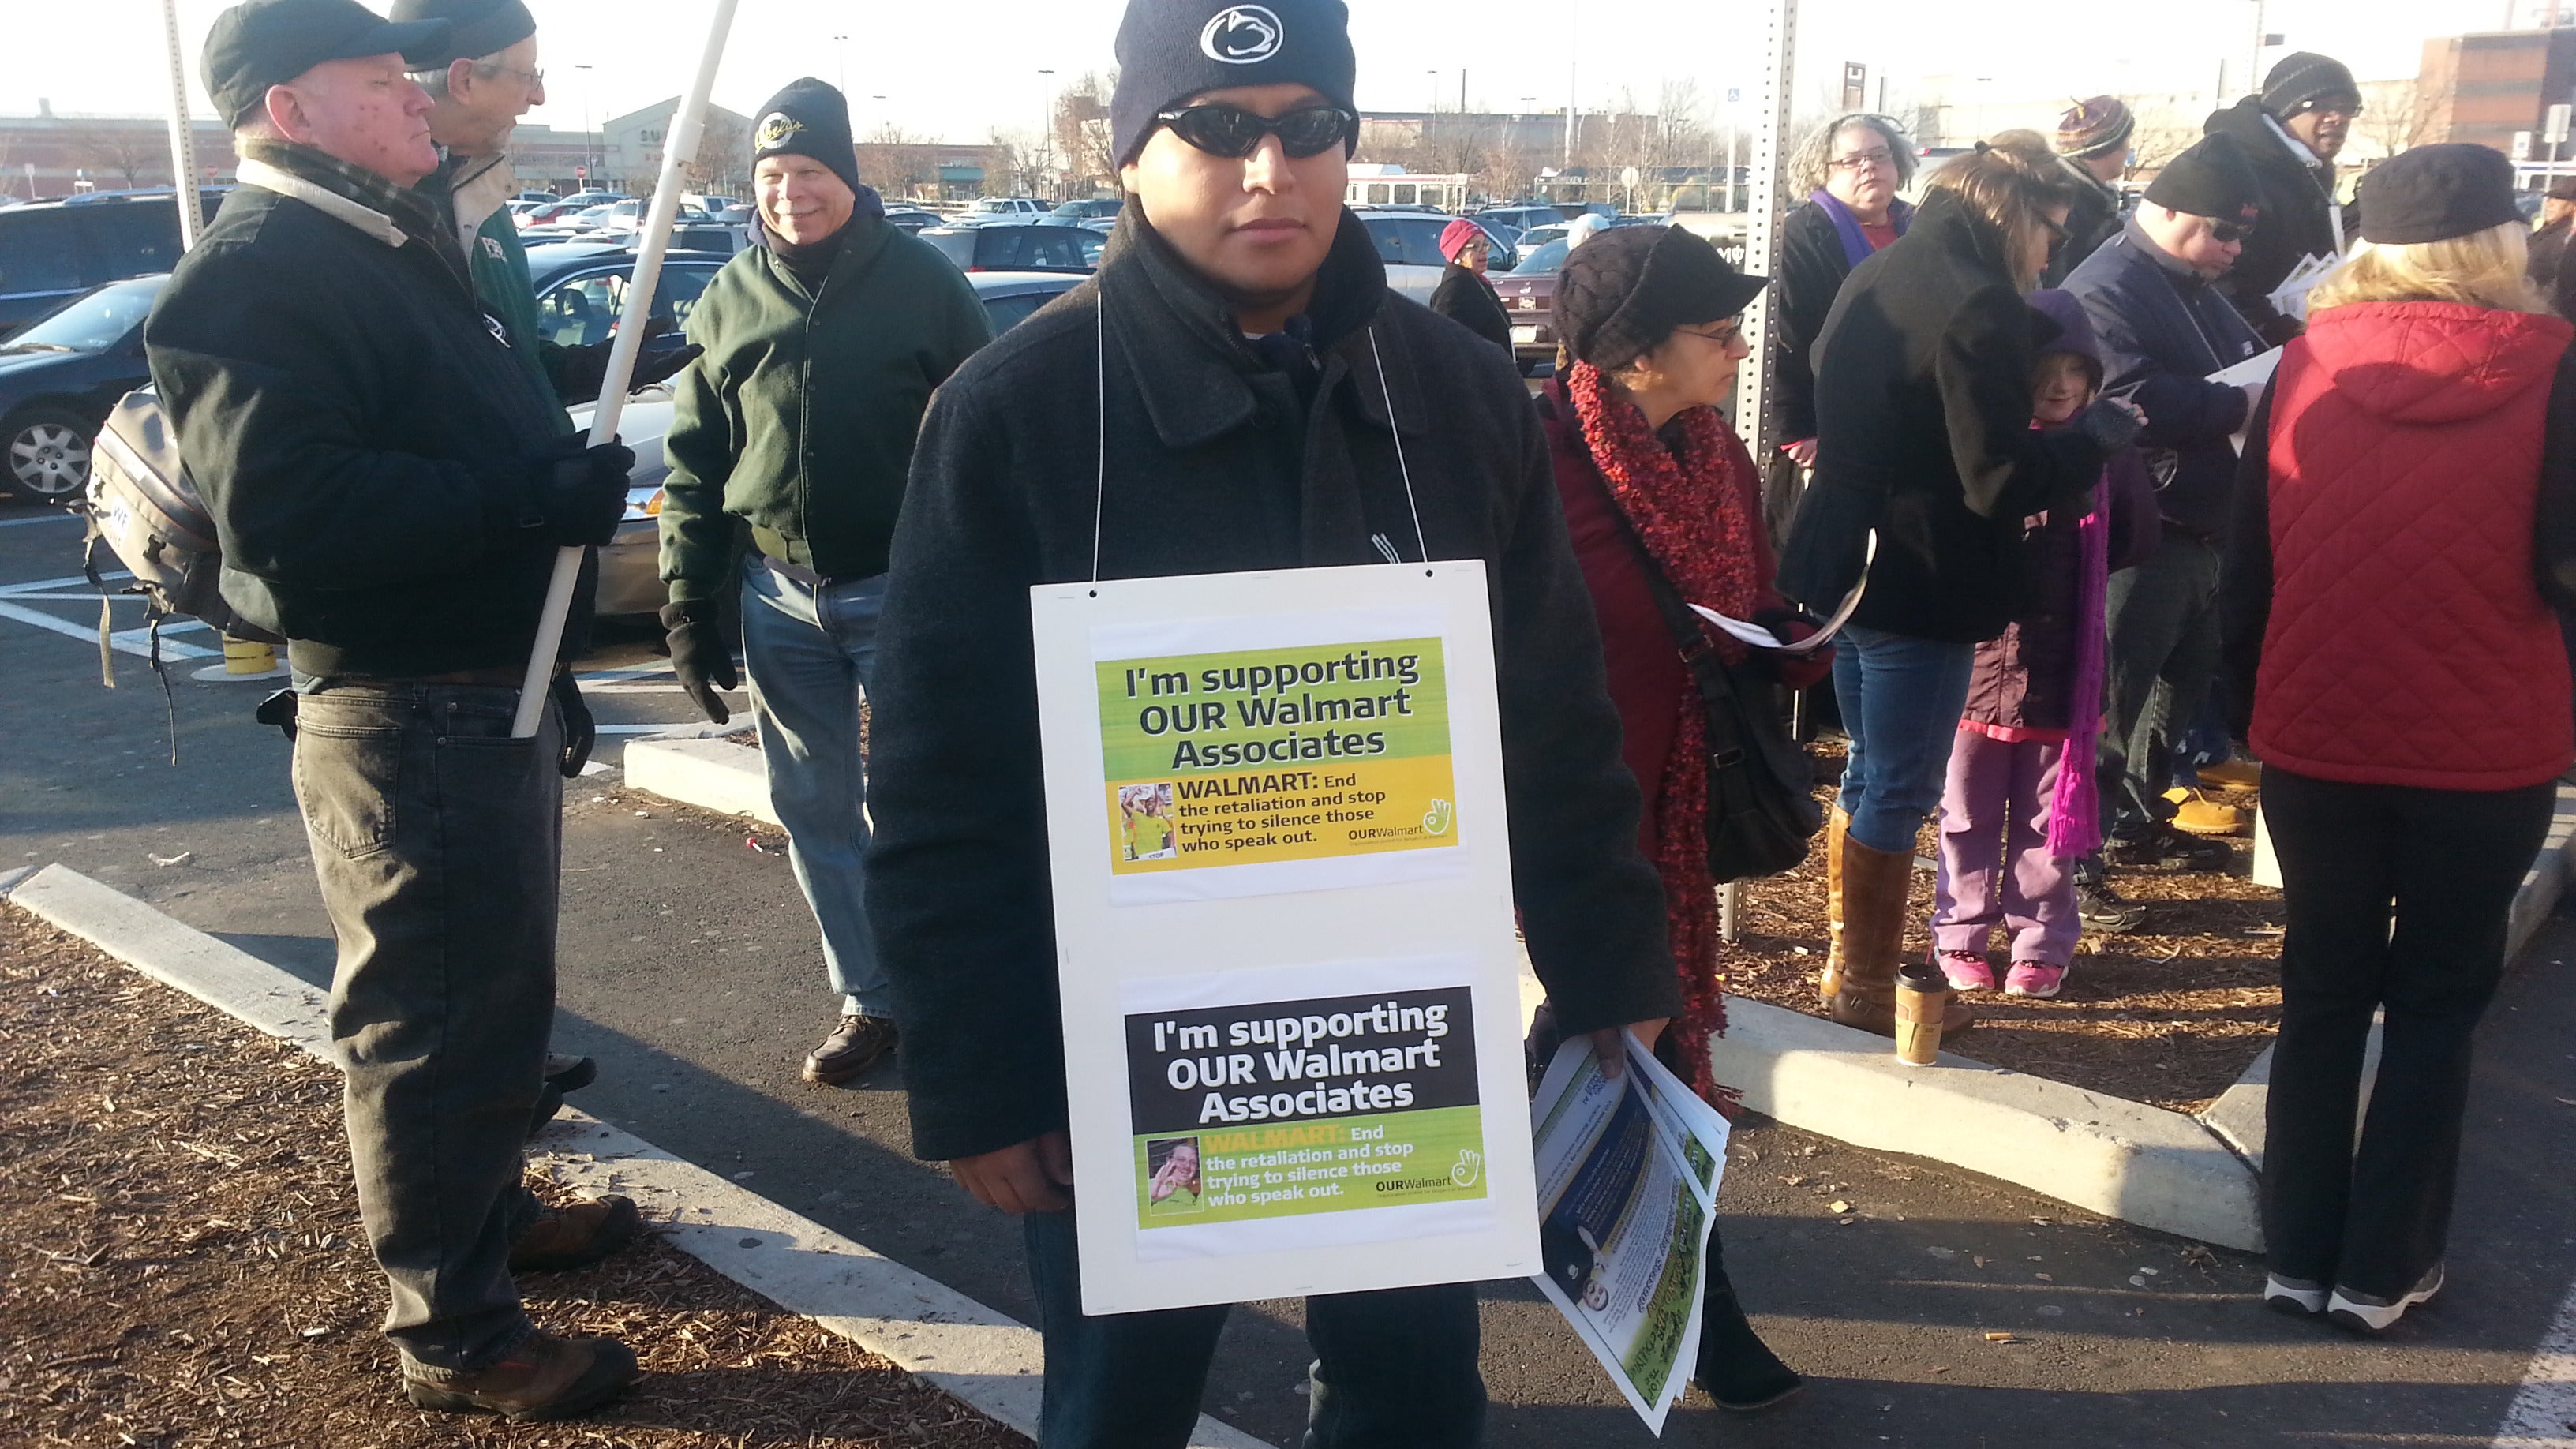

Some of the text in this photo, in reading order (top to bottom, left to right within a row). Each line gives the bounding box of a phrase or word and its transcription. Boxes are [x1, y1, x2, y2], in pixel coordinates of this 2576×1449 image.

[1125, 650, 1420, 698] I'm supporting
[1140, 687, 1412, 736] OUR Walmart
[1172, 728, 1386, 771] Associates
[1178, 772, 1356, 799] WALMART: End
[1179, 789, 1386, 817] the retaliation and stop
[1180, 807, 1375, 838] trying to silence those
[1349, 825, 1423, 841] OURWalmart
[1181, 830, 1317, 853] who speak out.
[1154, 1002, 1448, 1053] I'm supporting
[1168, 1038, 1441, 1090] OUR Walmart
[1199, 1080, 1414, 1124] Associates
[1205, 1124, 1383, 1155] WALMART: End
[1206, 1140, 1413, 1173] the retaliation and stop
[1208, 1160, 1402, 1193] trying to silence those
[1376, 1175, 1451, 1193] OURWalmart
[1208, 1183, 1343, 1207] who speak out.
